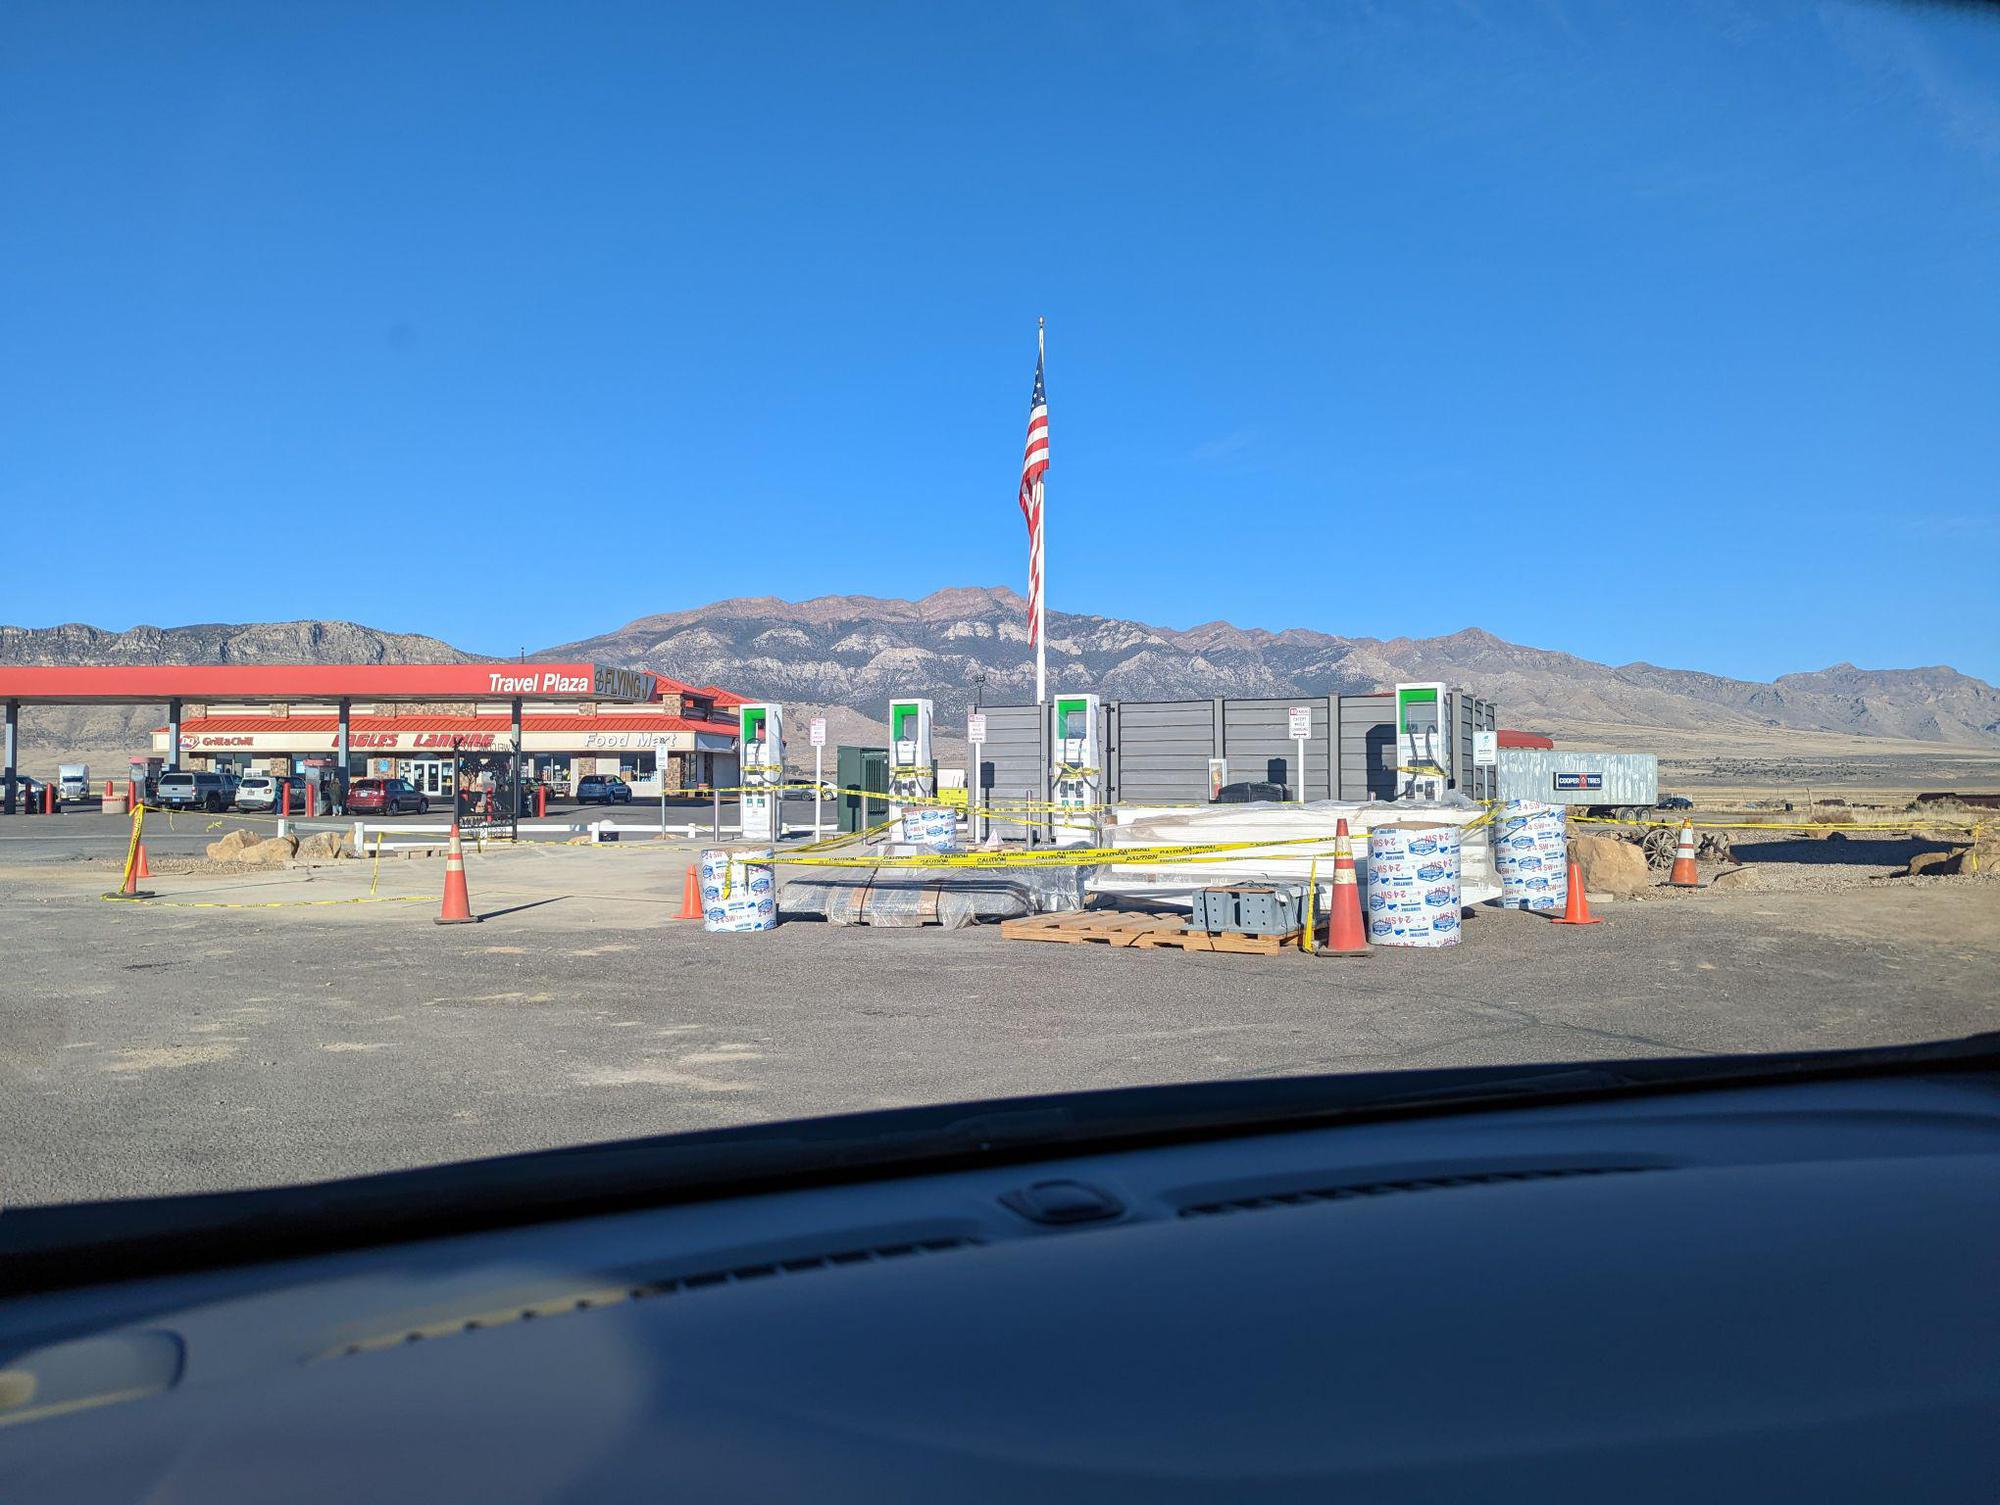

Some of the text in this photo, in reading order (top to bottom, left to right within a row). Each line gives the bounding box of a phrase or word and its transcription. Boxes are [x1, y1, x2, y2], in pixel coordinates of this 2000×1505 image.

[489, 673, 588, 692] Travel Plaza
[604, 669, 649, 699] FLYING J
[585, 733, 630, 748] Food
